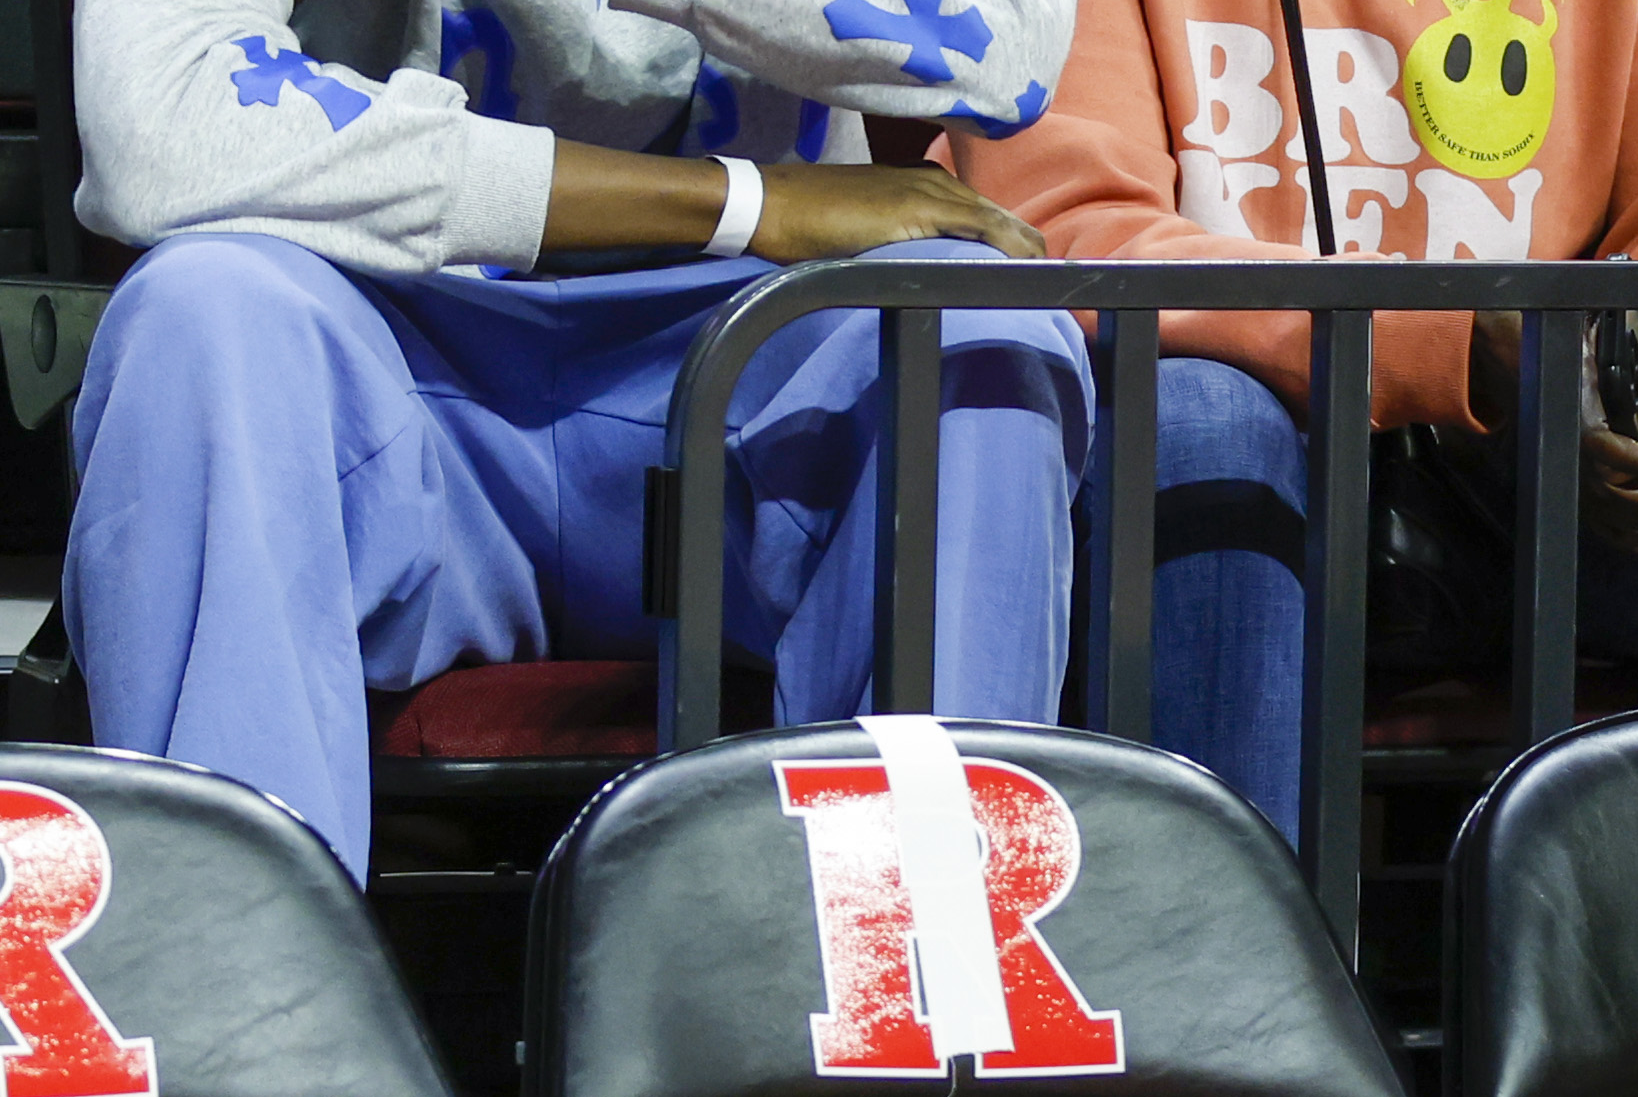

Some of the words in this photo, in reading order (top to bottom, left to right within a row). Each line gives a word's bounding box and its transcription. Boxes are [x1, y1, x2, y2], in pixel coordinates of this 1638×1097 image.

[1414, 81, 1441, 136] BETTER
[1438, 133, 1467, 157] SAFE
[1469, 149, 1500, 162] THAN
[1502, 132, 1536, 160] SORRY
